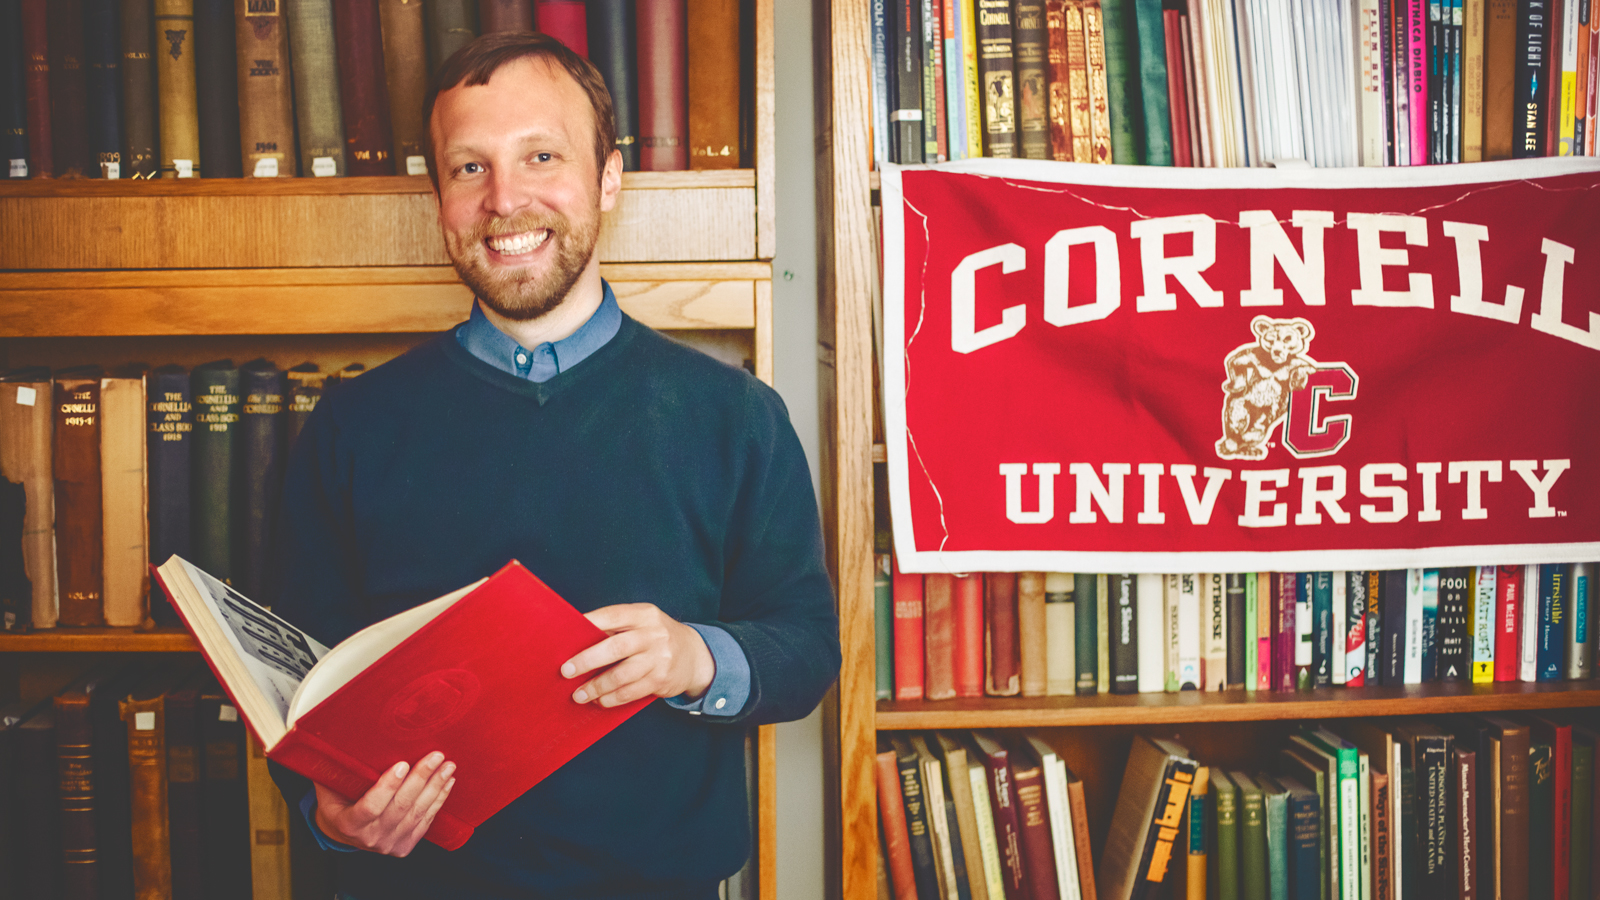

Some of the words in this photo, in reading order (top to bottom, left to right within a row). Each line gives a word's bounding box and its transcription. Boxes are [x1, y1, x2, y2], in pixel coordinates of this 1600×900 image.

[979, 9, 1011, 26] CORNELL
[1370, 9, 1378, 51] PLUM
[1528, 14, 1543, 28] OF
[1396, 16, 1405, 66] BELOVED
[1527, 34, 1543, 67] LIGHT
[1413, 48, 1422, 93] DIABLO
[1526, 103, 1538, 129] STAN
[1525, 132, 1537, 151] LEE
[951, 209, 1600, 353] CORNELL
[164, 392, 182, 402] THE
[164, 413, 182, 422] AND
[998, 458, 1570, 528] UNIVERSITY
[1120, 579, 1132, 606] Long
[1440, 577, 1468, 590] FOOL
[1506, 583, 1516, 602] PAUL
[1552, 573, 1563, 624] irresistible
[1479, 587, 1494, 621] MATT
[1505, 603, 1515, 633] McEUEN
[1120, 606, 1133, 645] Silence
[1170, 605, 1179, 649] SEGAL
[1428, 766, 1436, 797] UNITED
[1438, 767, 1446, 814] POISONOUS
[1461, 763, 1469, 790] Minnie
[1375, 785, 1388, 818] Ways
[1428, 798, 1436, 827] STATES
[1378, 819, 1388, 833] of
[1438, 814, 1446, 846] PLANTS
[1378, 835, 1387, 855] the
[1463, 854, 1471, 892] Cookbook
